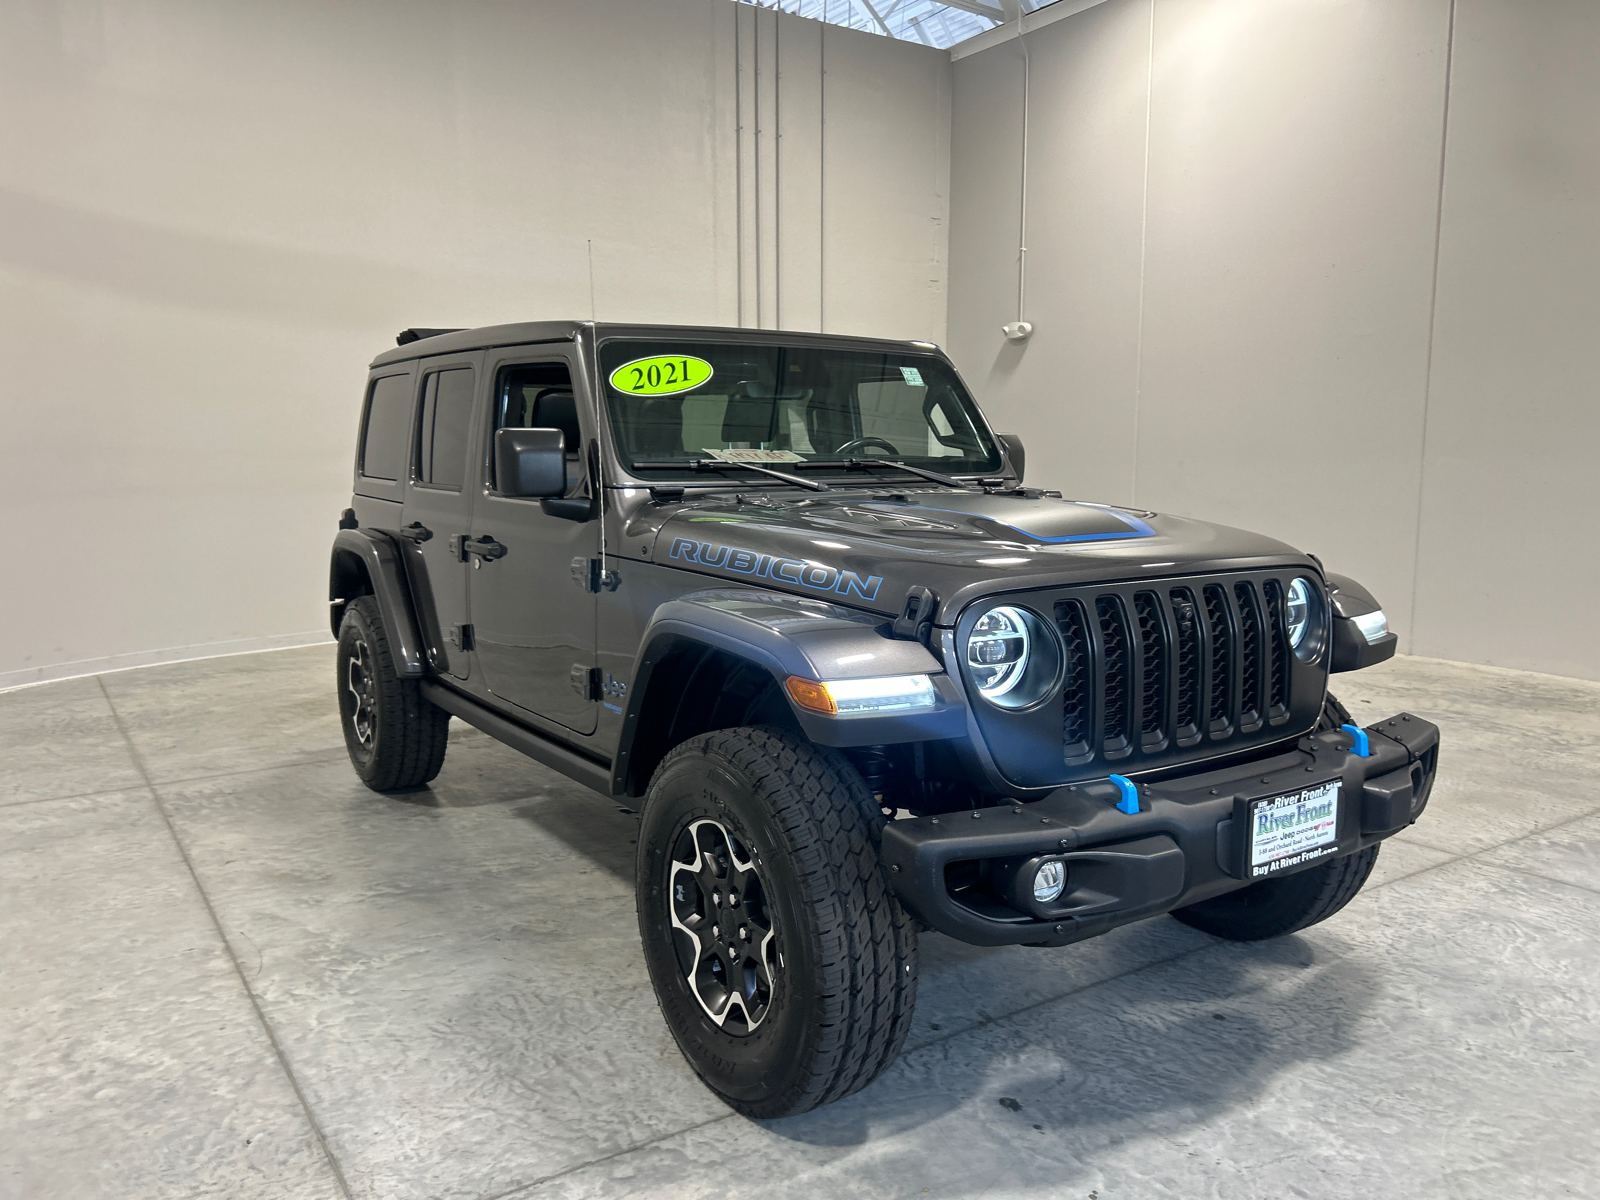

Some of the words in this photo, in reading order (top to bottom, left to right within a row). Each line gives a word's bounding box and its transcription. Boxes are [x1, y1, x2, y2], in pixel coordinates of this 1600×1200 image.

[630, 360, 691, 390] 2021
[669, 536, 883, 601] RUBICON
[1274, 795, 1300, 809] River
[1301, 786, 1325, 802] Front
[1256, 811, 1295, 836] River
[1295, 800, 1333, 825] Front
[1268, 845, 1276, 853] and
[1292, 837, 1303, 846] Road
[1280, 831, 1296, 841] Jeep
[1253, 864, 1269, 876] Buy
[1270, 860, 1280, 872] At
[1280, 854, 1301, 869] River
[1301, 846, 1338, 862] Front.com
